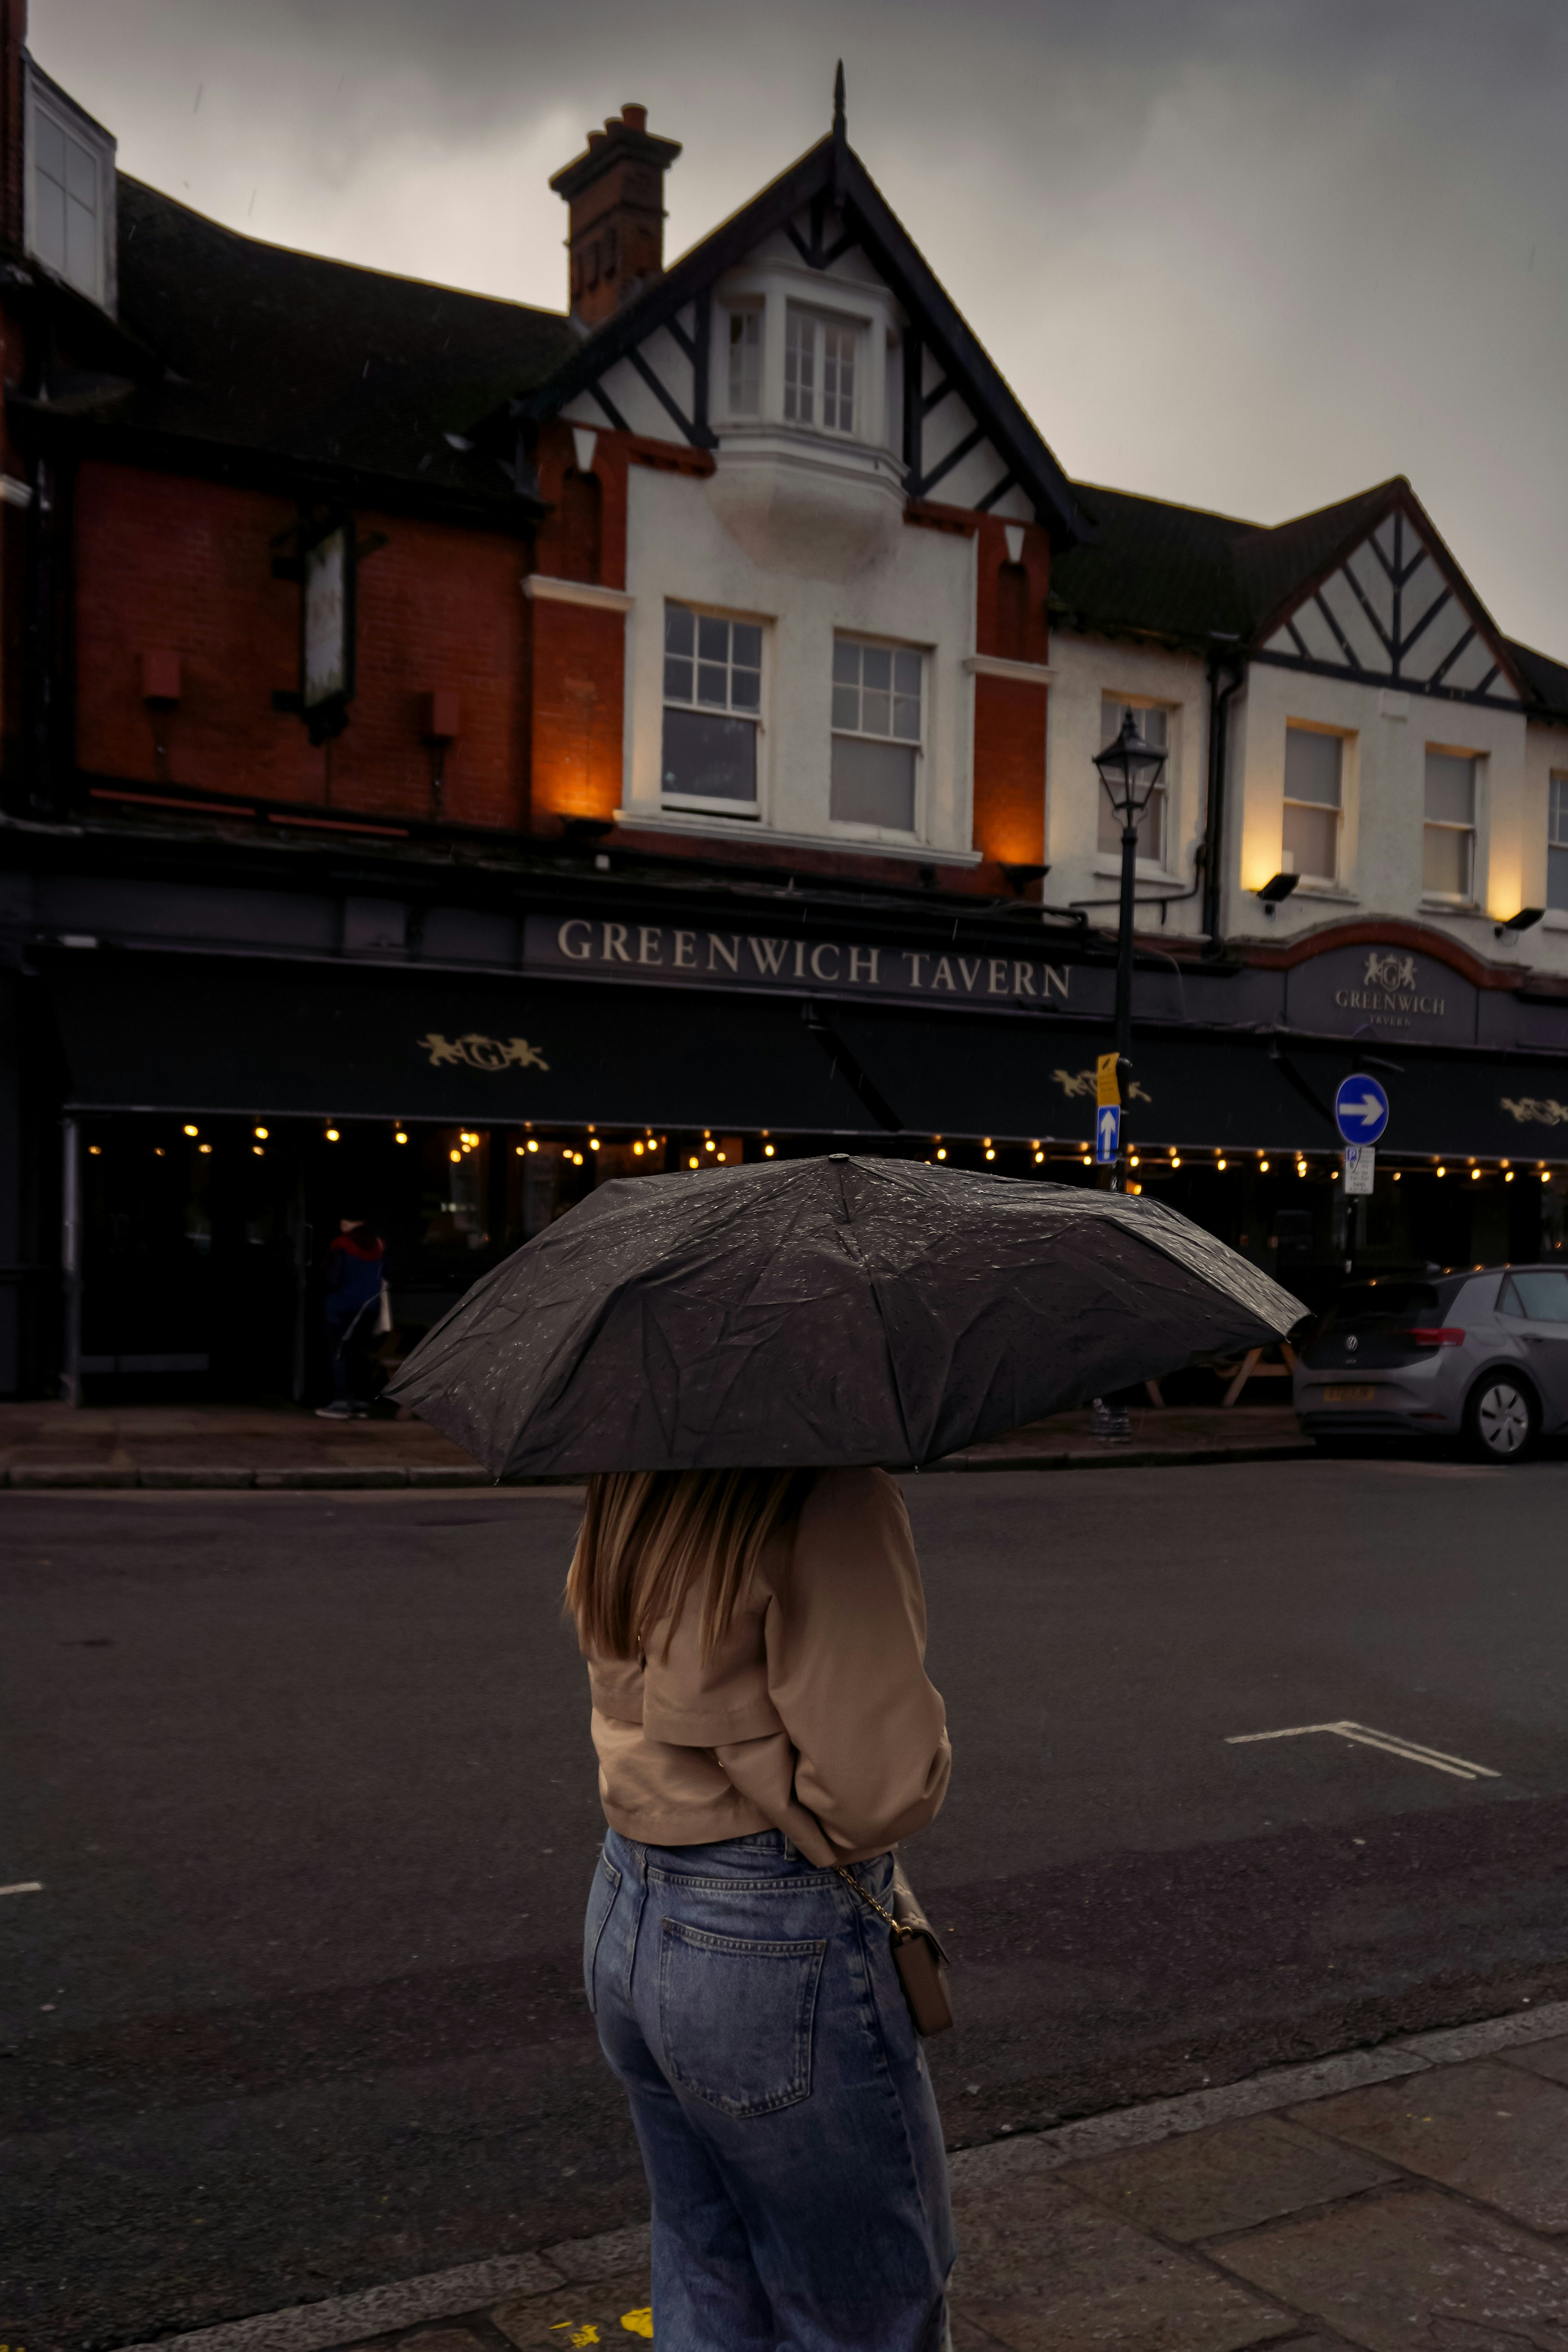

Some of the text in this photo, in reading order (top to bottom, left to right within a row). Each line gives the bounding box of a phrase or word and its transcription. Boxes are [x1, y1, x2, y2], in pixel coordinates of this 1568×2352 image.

[557, 919, 1072, 999] GREENWICH TAVERN
[1335, 989, 1445, 1015] GREENWICH
[1370, 1015, 1411, 1027] TAVERN
